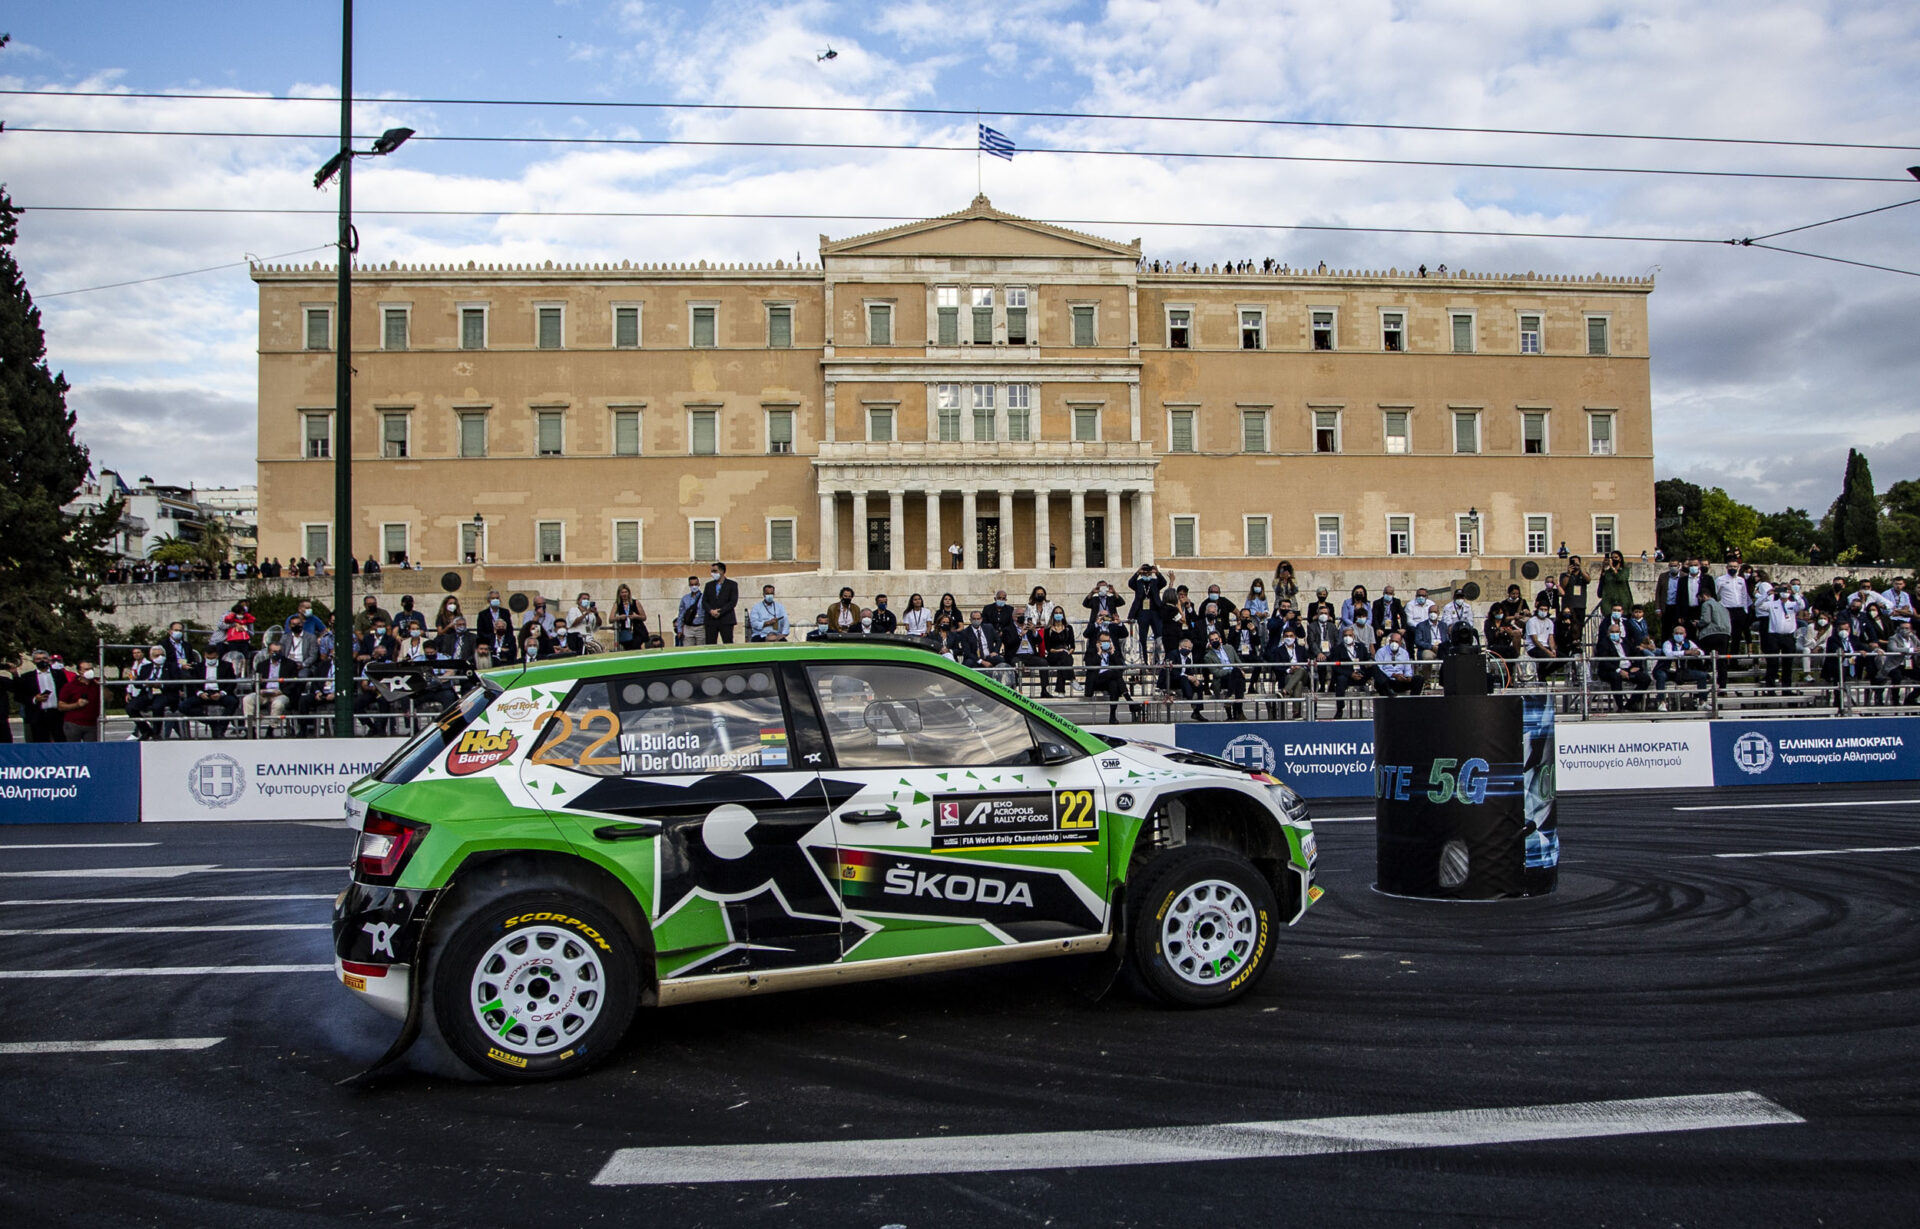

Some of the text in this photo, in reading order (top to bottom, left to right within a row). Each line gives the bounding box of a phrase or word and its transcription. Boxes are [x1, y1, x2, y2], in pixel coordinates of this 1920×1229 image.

[497, 701, 540, 711] Hard Rock
[457, 730, 514, 754] Hot
[532, 710, 621, 766] 22
[641, 732, 700, 751] Bulacia
[1779, 736, 1904, 750] ΕΛΛΗΝΙΚΗ ΔΗΜΟΚΡΑΤΙΑ
[1284, 742, 1357, 757] ΕΛΛΗΝΙΚΗ
[1559, 741, 1689, 755] ΕΛΛΗΝΙΚΗ ΔΗΜΟΚΡΑΤΙΑ
[458, 753, 503, 764] Burger
[641, 754, 669, 771] Der
[671, 751, 760, 770] Ohannesian
[1102, 760, 1121, 768] OMP
[1559, 756, 1682, 771] Υφυπουργείο Αθλητισμού
[1780, 750, 1897, 765] Υφυπουργείο Αθλητισμού
[256, 763, 334, 776] ΕΛΛΗΝΙΚΗ
[1285, 760, 1367, 776] Υφυπουργείο
[1427, 757, 1490, 804] 5G
[256, 781, 346, 797] Υφυπουργείο
[994, 807, 1034, 816] ACROPOLIS
[1059, 790, 1094, 829] 22
[994, 814, 1049, 824] RALLY OF GODS
[962, 837, 974, 845] FIA
[975, 836, 994, 844] World
[996, 835, 1013, 844] Rally
[1014, 833, 1059, 843] Championship
[883, 862, 1034, 908] ŠKODA
[504, 912, 612, 953] SCORPION
[1229, 909, 1268, 991] SCORPION
